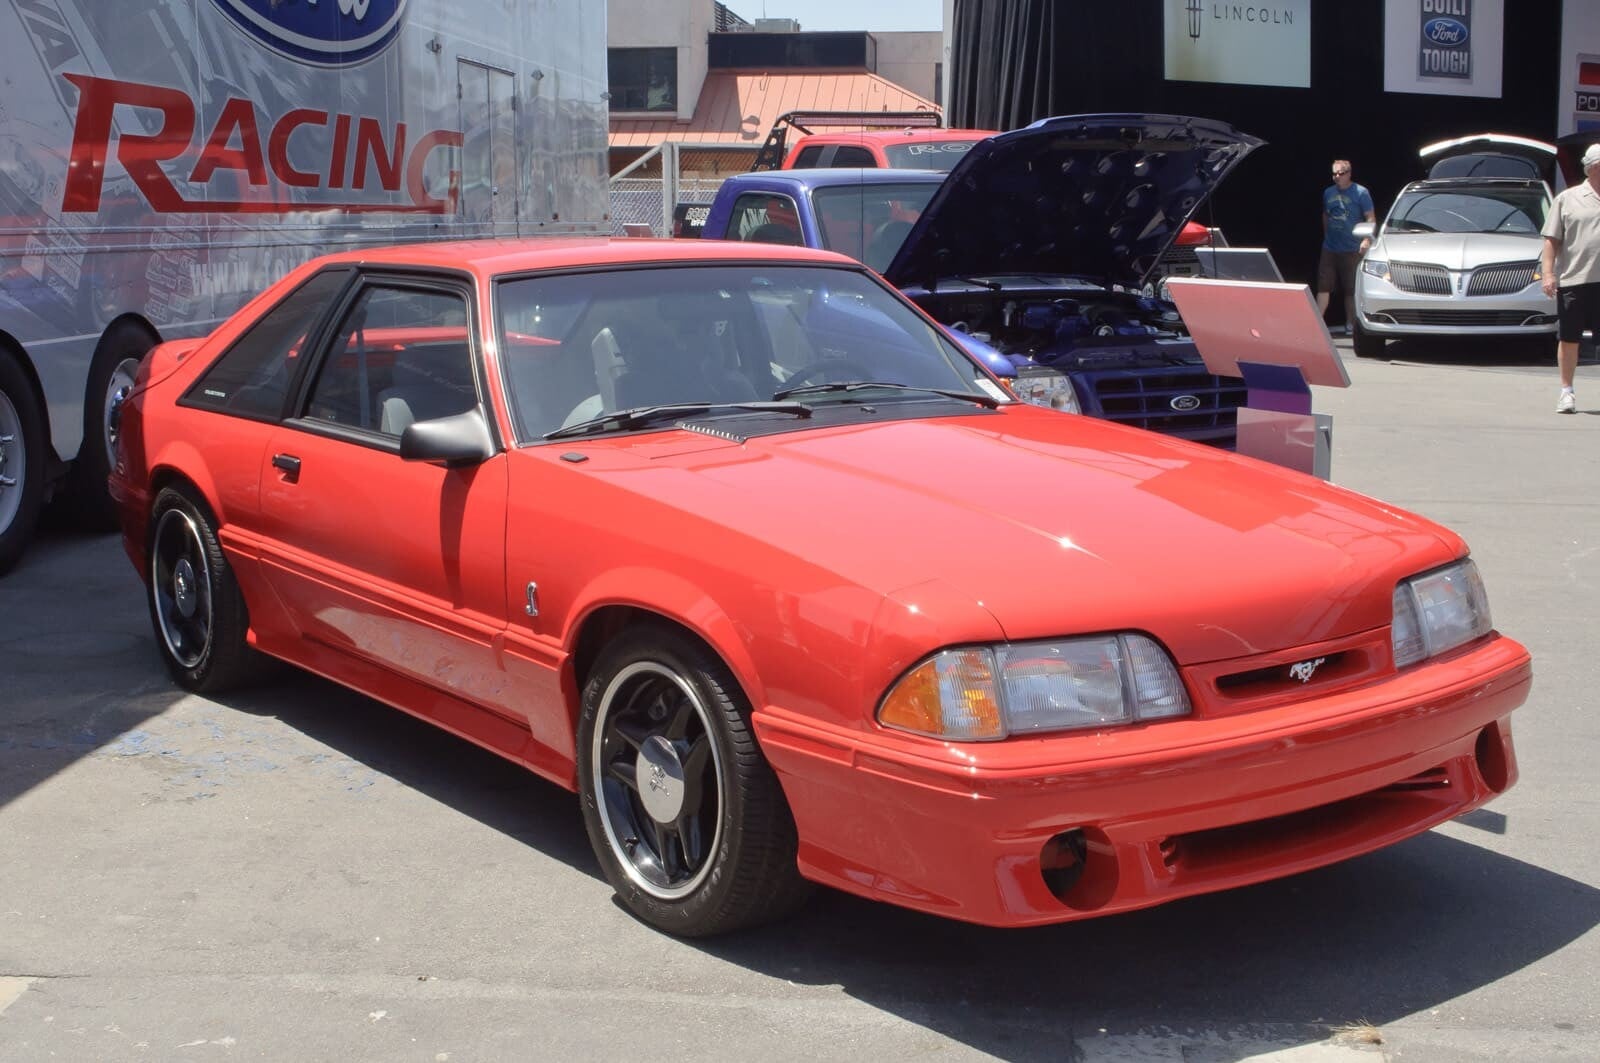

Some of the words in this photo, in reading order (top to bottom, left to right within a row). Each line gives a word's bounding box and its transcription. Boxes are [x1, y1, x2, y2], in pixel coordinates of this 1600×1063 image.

[1213, 4, 1293, 24] LINCOLN
[1431, 20, 1461, 42] Ford
[1422, 48, 1469, 74] TOUGH
[1578, 95, 1600, 111] PO
[62, 72, 464, 214] RACING
[908, 143, 977, 155] RO
